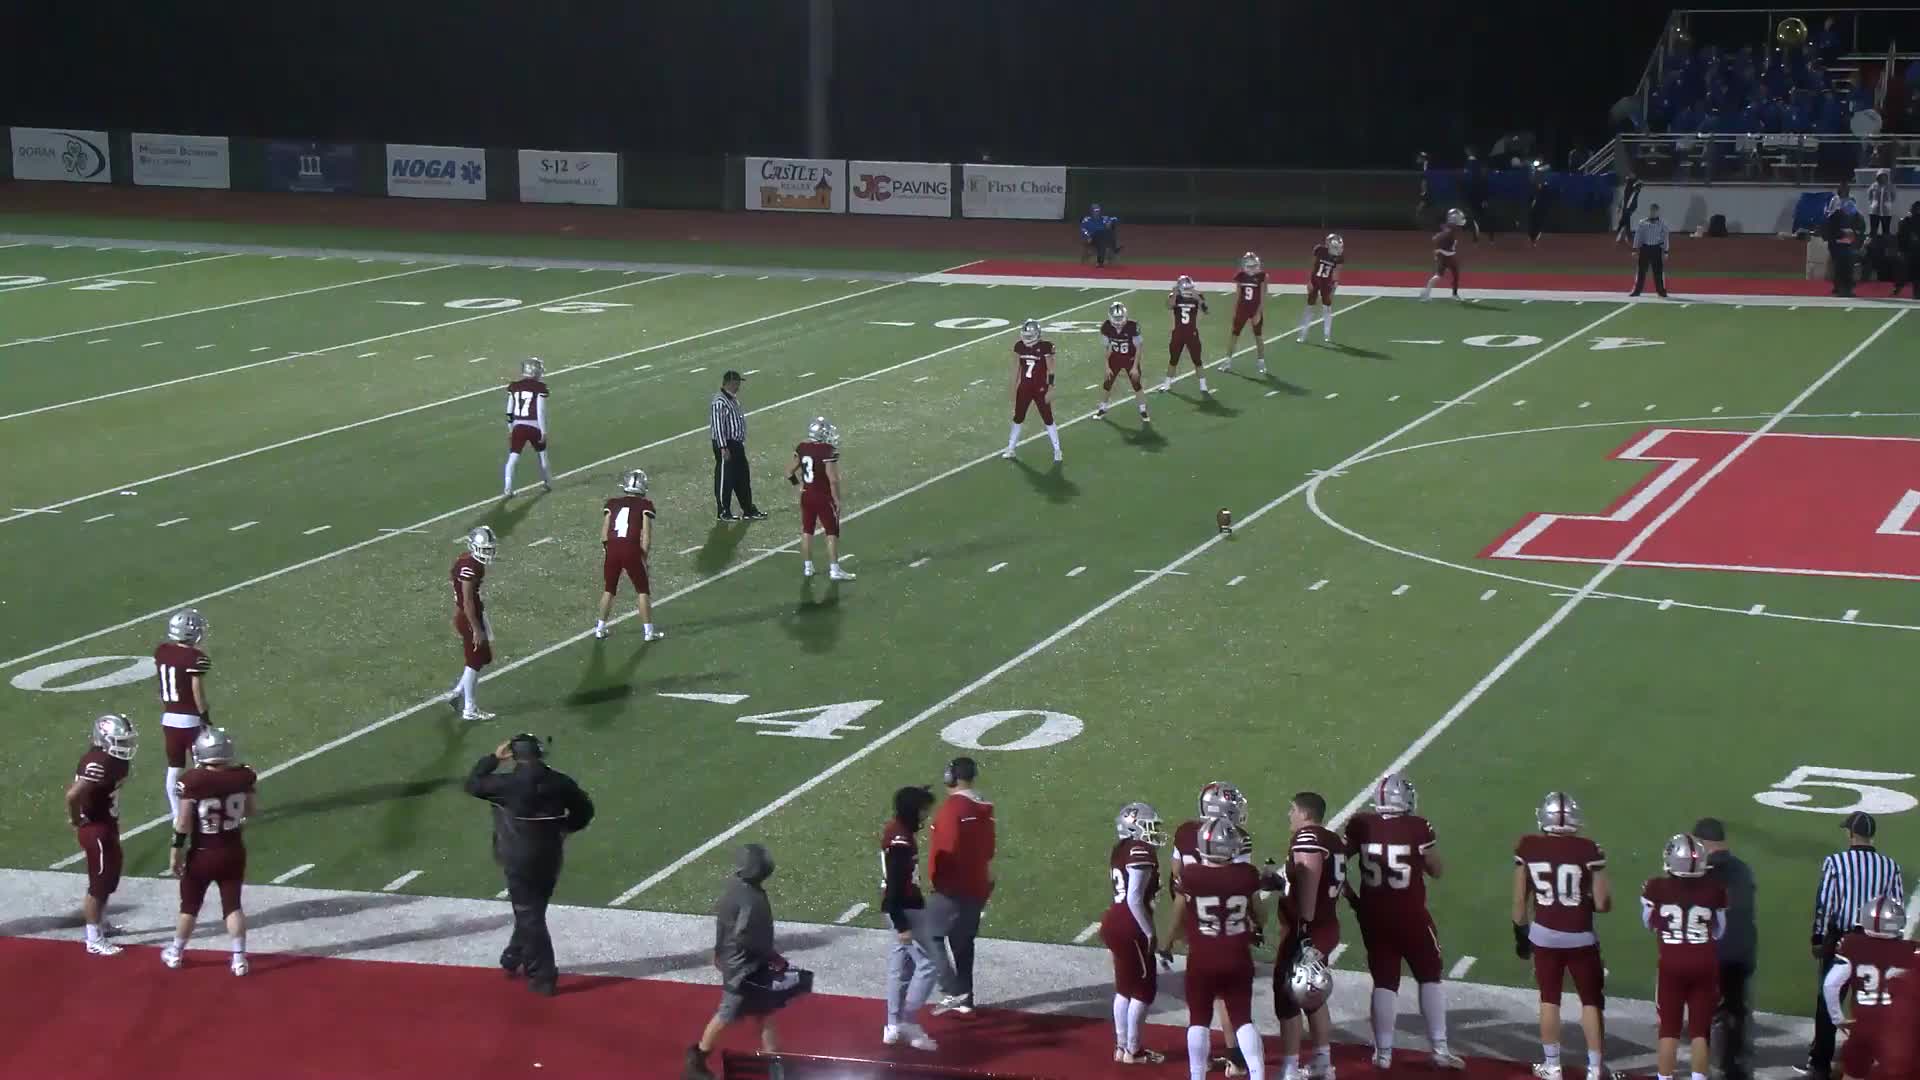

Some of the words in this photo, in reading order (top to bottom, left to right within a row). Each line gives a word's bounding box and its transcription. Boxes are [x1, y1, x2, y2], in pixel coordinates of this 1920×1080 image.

[391, 159, 456, 178] NOGA
[892, 180, 947, 195] PAVING
[987, 180, 1017, 193] First
[1020, 181, 1064, 194] Choice
[1244, 286, 1255, 301] 9
[1180, 307, 1191, 325] 5
[1025, 359, 1036, 379] 7
[512, 391, 534, 418] 17
[800, 455, 816, 484] 3
[613, 506, 631, 538] 4
[159, 663, 179, 702] 11
[1752, 765, 1919, 814] 5
[1360, 843, 1412, 889] 55
[1527, 862, 1583, 907] 50
[1195, 896, 1249, 937] 52
[1659, 904, 1713, 945] 36
